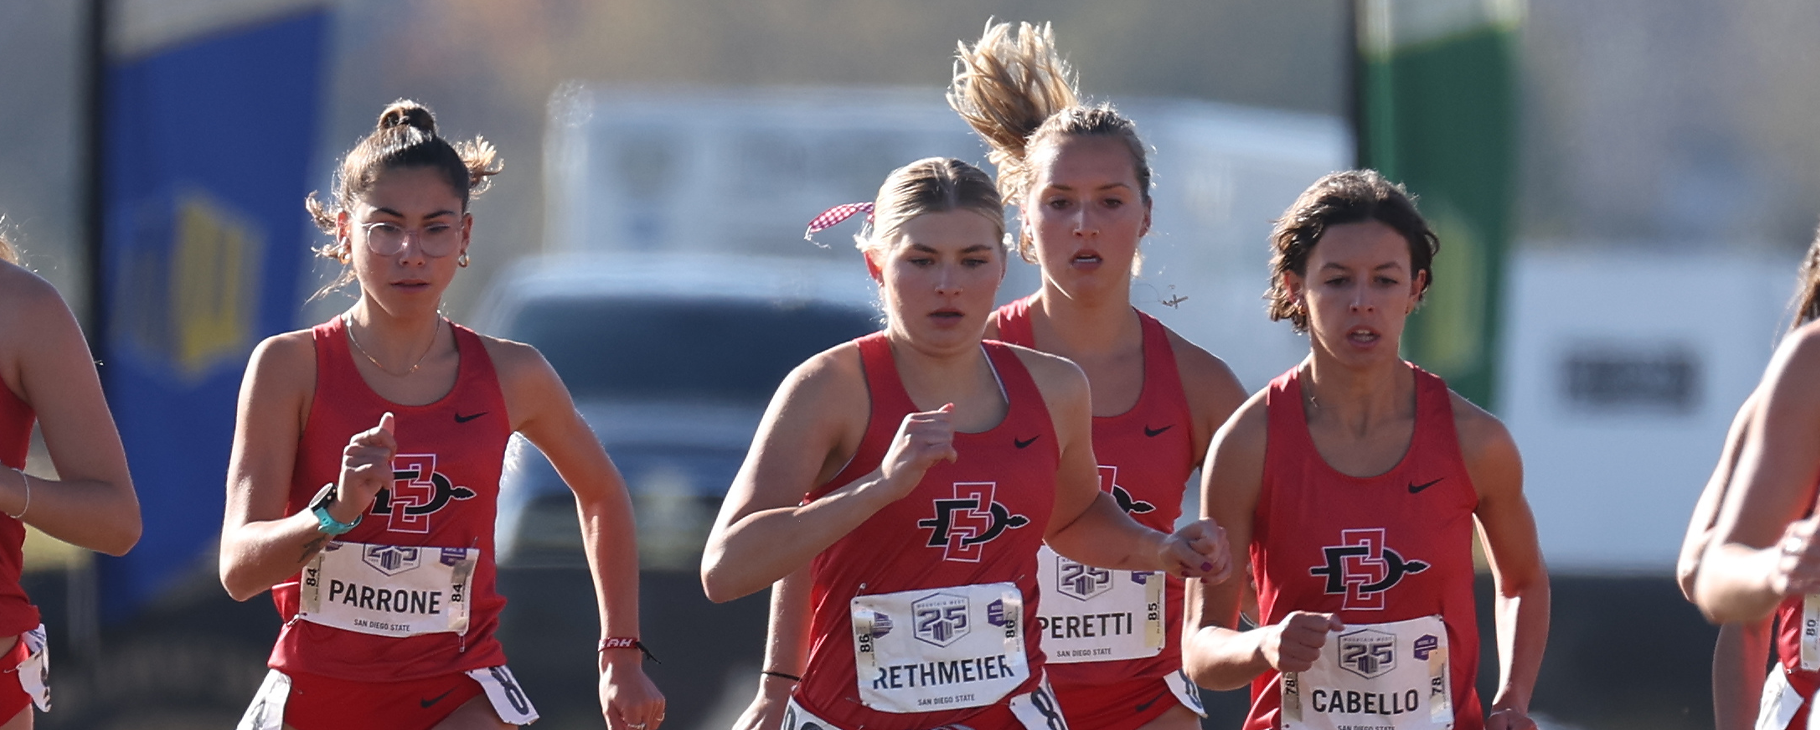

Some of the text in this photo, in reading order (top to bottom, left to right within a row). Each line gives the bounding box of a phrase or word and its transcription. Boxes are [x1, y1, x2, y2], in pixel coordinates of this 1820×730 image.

[306, 568, 317, 587] 84
[328, 579, 443, 615] PARRONE
[451, 583, 463, 602] 84
[917, 604, 967, 633] 25
[1147, 602, 1158, 621] 85
[353, 618, 411, 632] SAN DIEGO STATE
[1004, 619, 1017, 638] 86
[1036, 612, 1133, 639] PERETTI
[1806, 619, 1816, 636] 80
[858, 633, 871, 653] 86
[1056, 647, 1112, 658] SAN DIEGO STATE
[1343, 642, 1393, 664] 25
[873, 654, 1015, 690] RETHMEIER
[1285, 679, 1296, 696] 78
[1431, 676, 1443, 697] 78
[917, 693, 976, 706] SAN DIEGO STATE
[1312, 689, 1419, 716] CABELLO
